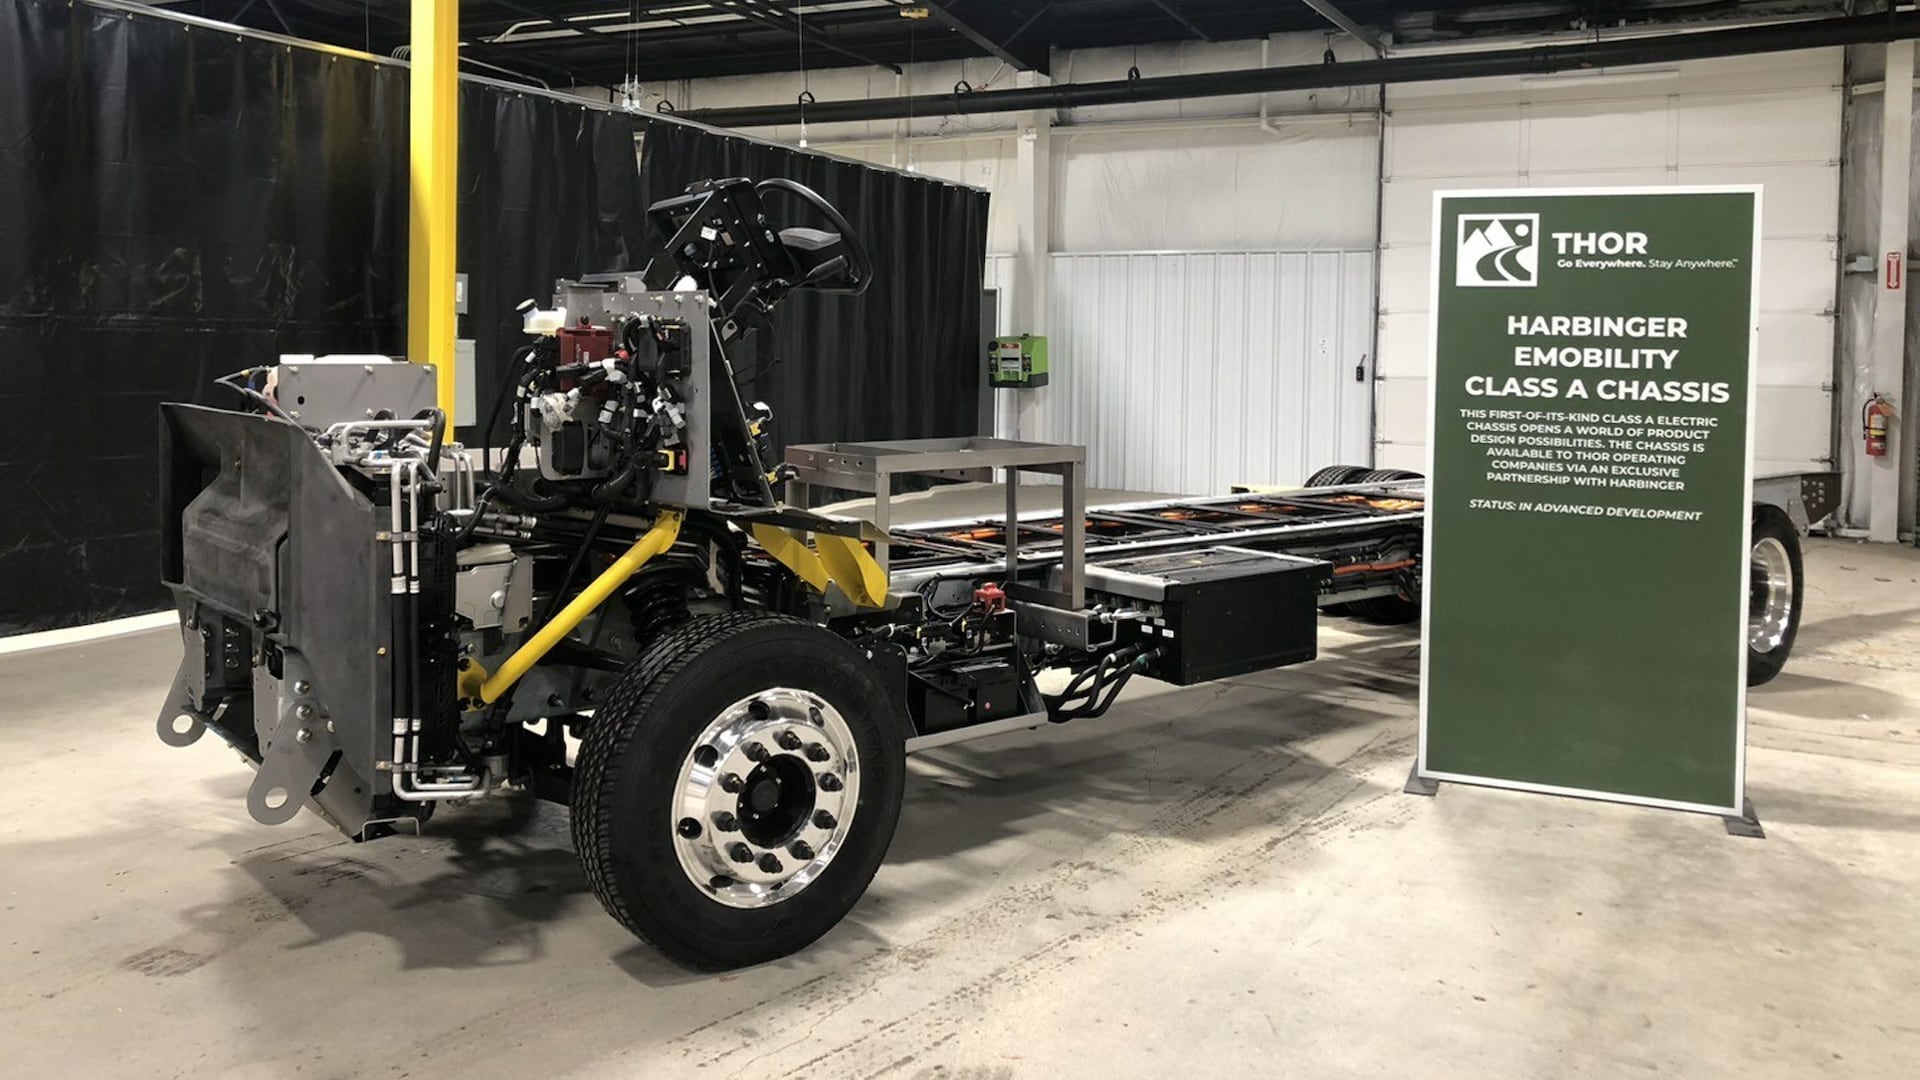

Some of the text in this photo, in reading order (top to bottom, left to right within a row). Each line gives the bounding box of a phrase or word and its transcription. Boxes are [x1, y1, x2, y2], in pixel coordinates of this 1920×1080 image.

[1552, 232, 1648, 255] THOR
[1557, 259, 1573, 268] Go
[1575, 259, 1646, 270] Everywhere.
[1649, 259, 1673, 269] Stay
[1508, 315, 1687, 338] HARBINGER
[1515, 346, 1679, 369] EMOBILITY
[1465, 376, 1730, 403] CLASS A CHASSIS
[1460, 409, 1718, 427] THIS FIRST-OF-ITS-KIND CLASS A ELECTRIC
[1466, 421, 1710, 439] CHASSIS OPENS A WORLD OF PRODUCT
[1471, 434, 1705, 452] DESIGN POSSIBILITIES. THE CHASSIS IS
[1486, 447, 1686, 465] AVAILABLE TO THOR OPERATING
[1492, 460, 1679, 478] COMPANIES VIA AN EXCLUSIVE
[1487, 472, 1685, 490] PARTNERSHIP WITH HARBINGER
[1470, 499, 1702, 520] STATUS: IN ADVANCED DEVELOPMENT
